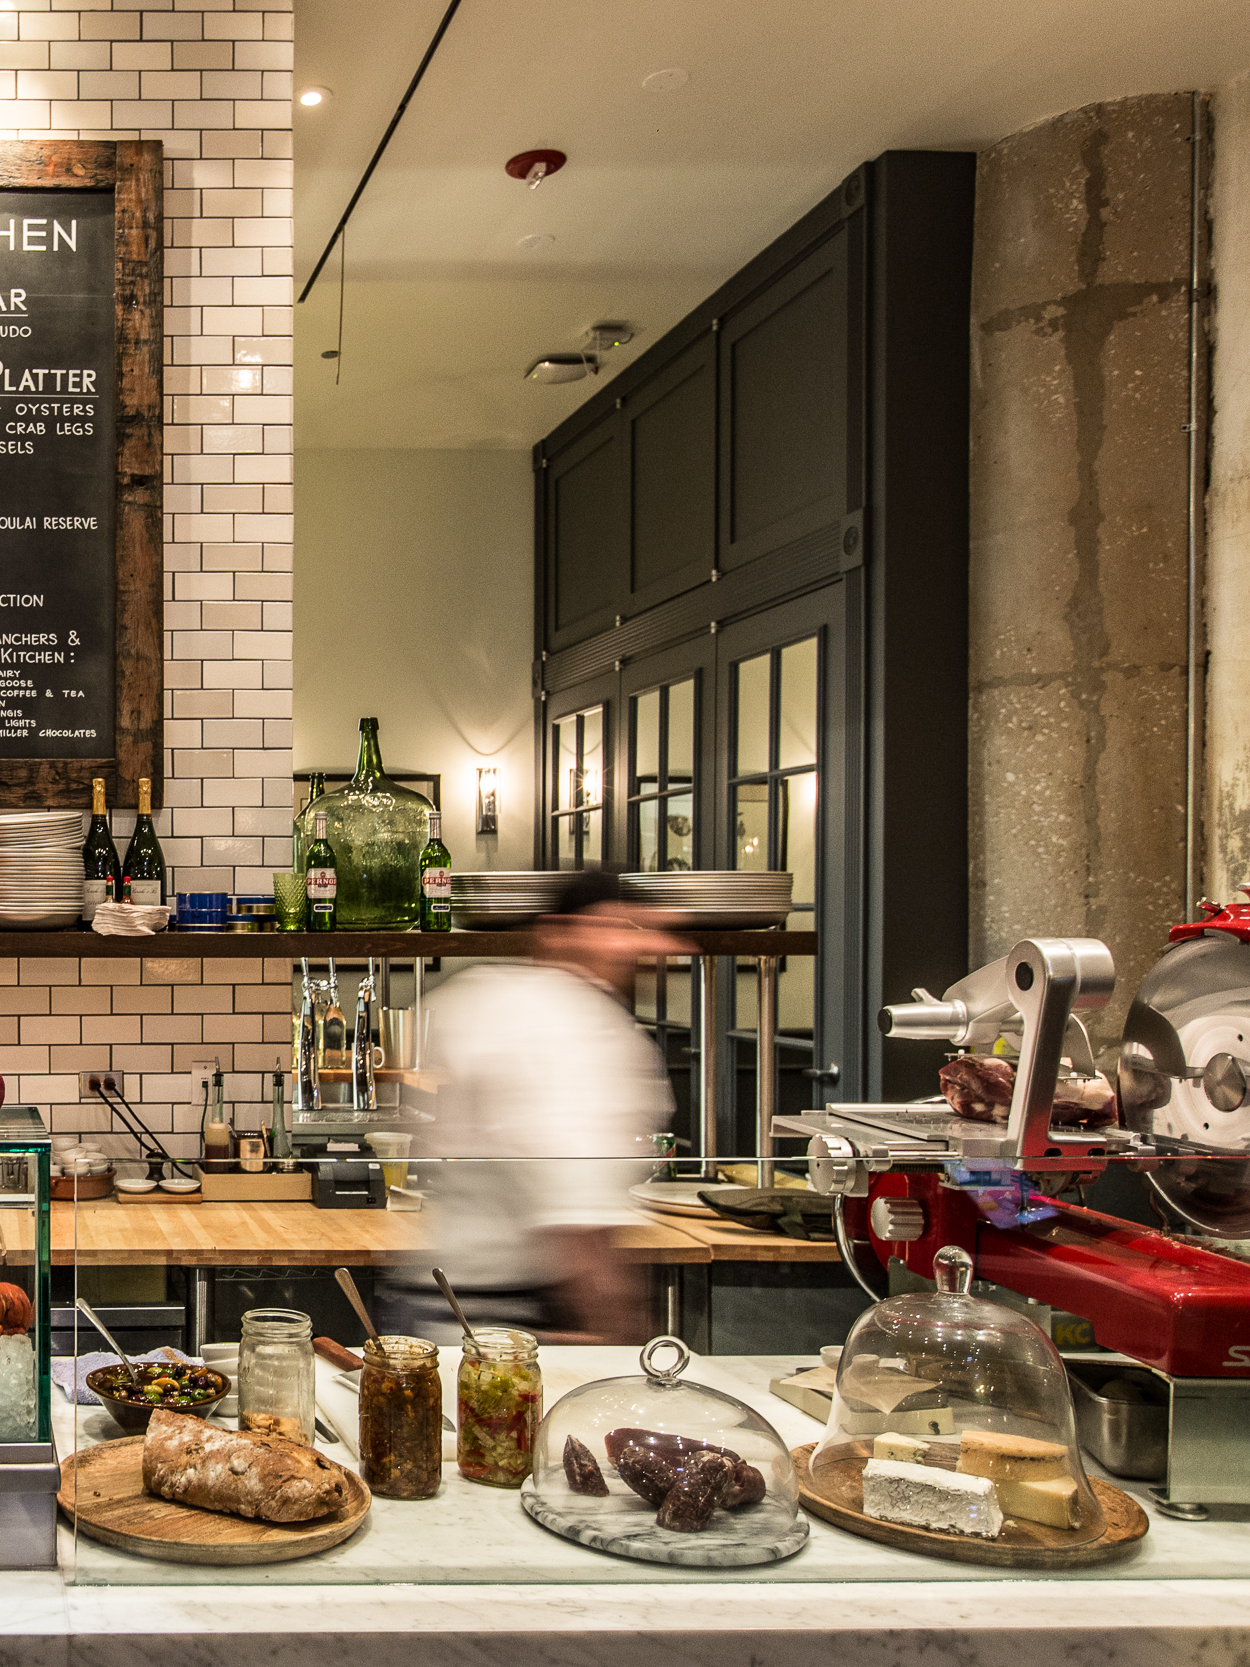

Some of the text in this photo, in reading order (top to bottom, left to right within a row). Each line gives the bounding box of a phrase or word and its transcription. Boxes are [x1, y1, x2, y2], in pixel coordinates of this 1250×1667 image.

[15, 403, 95, 417] OYSTERS
[5, 421, 46, 436] CRAB
[56, 422, 94, 436] LEGS
[43, 516, 99, 530] RESERVE
[67, 629, 81, 647] &
[0, 689, 38, 698] COFFEE
[44, 688, 54, 698] &
[61, 689, 85, 698] TEA
[4, 718, 37, 728] LIGHTS
[38, 728, 97, 738] CHOCOLATES
[1056, 1323, 1090, 1345] KC
